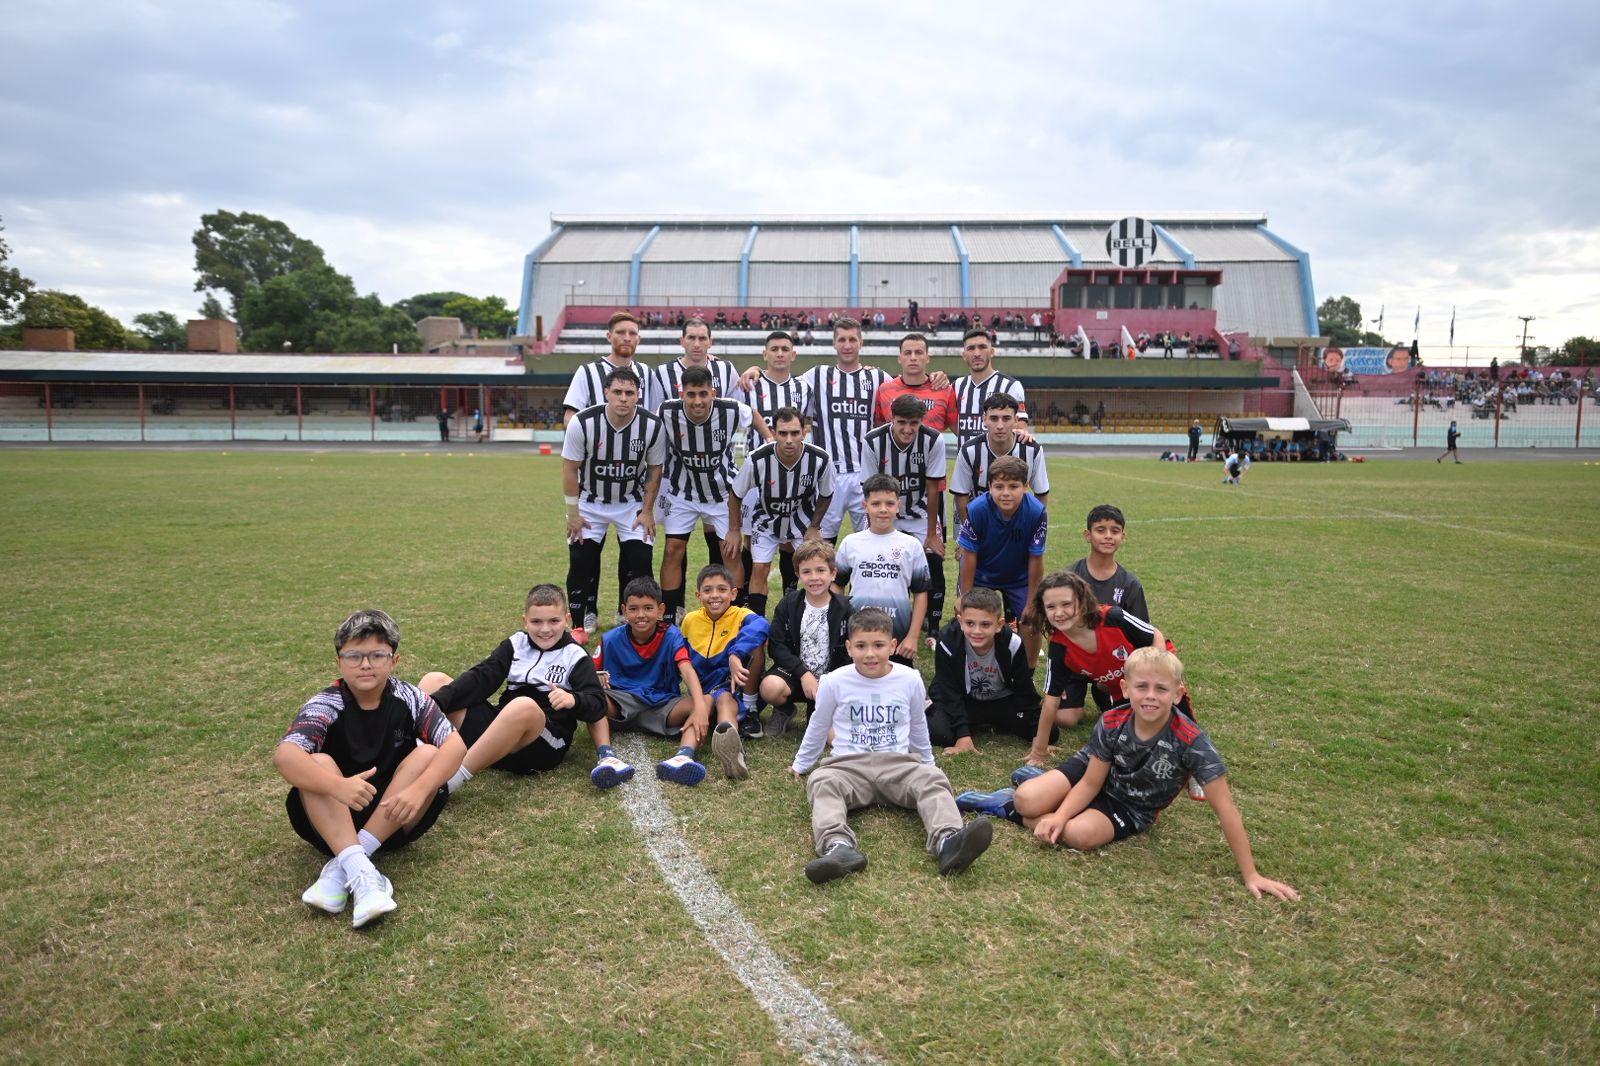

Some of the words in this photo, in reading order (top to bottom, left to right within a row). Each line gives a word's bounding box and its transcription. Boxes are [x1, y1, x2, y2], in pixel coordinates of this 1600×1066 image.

[1113, 239, 1150, 248] BELL
[831, 400, 868, 414] atila
[683, 454, 720, 468] atila
[594, 462, 637, 477] atila
[899, 476, 920, 490] ila
[858, 561, 901, 572] Esportes
[850, 705, 901, 724] MUSIC
